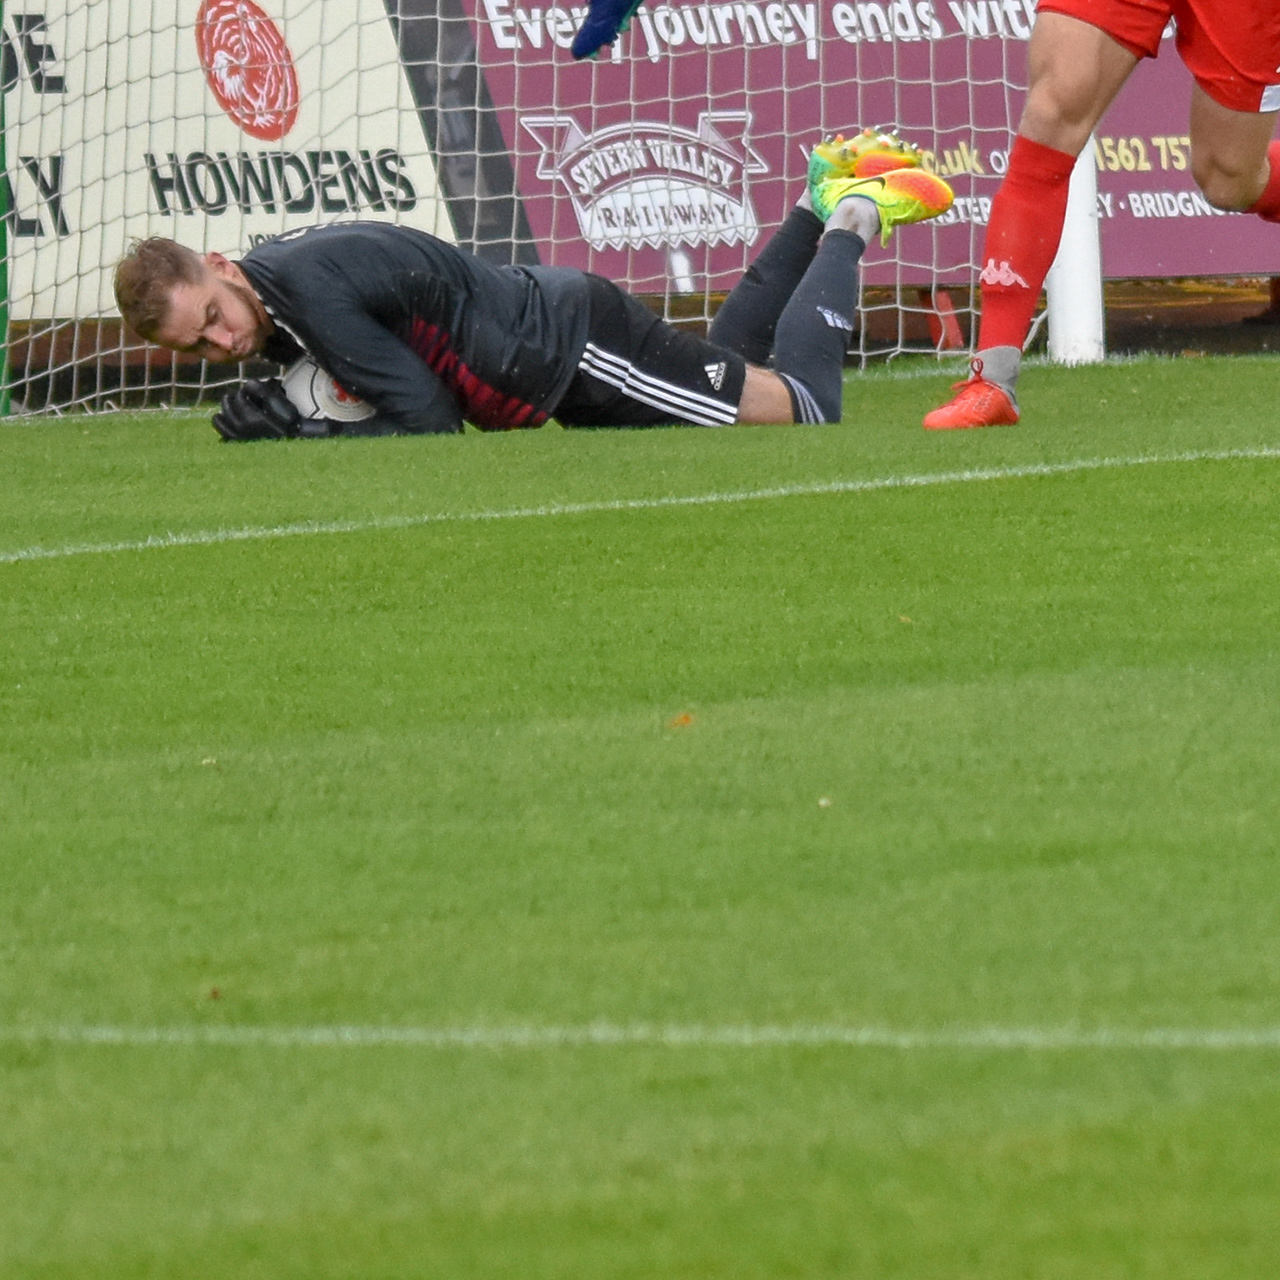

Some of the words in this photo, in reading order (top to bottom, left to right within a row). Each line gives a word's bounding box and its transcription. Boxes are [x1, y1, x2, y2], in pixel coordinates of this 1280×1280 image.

[638, 0, 816, 63] journey
[144, 148, 417, 216] HOWDENS
[571, 139, 648, 194] SEVERN
[646, 139, 734, 189] VALLEY
